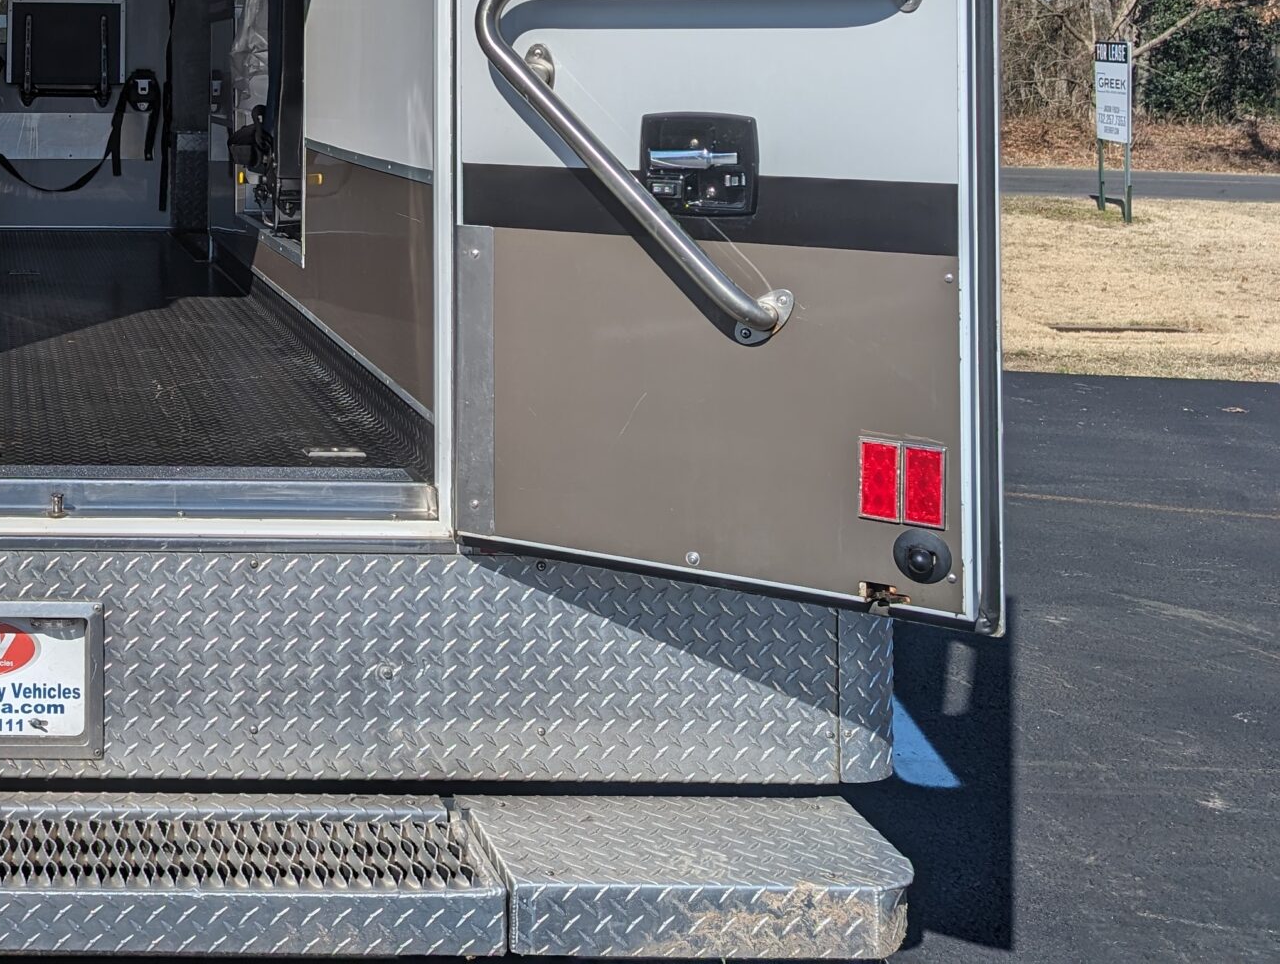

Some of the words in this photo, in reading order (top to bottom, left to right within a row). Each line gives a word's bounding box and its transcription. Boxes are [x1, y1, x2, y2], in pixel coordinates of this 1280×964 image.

[1096, 43, 1108, 61] FOR
[1108, 44, 1126, 62] LEASE
[1098, 77, 1126, 91] GREEK
[11, 683, 81, 700] Vehicles
